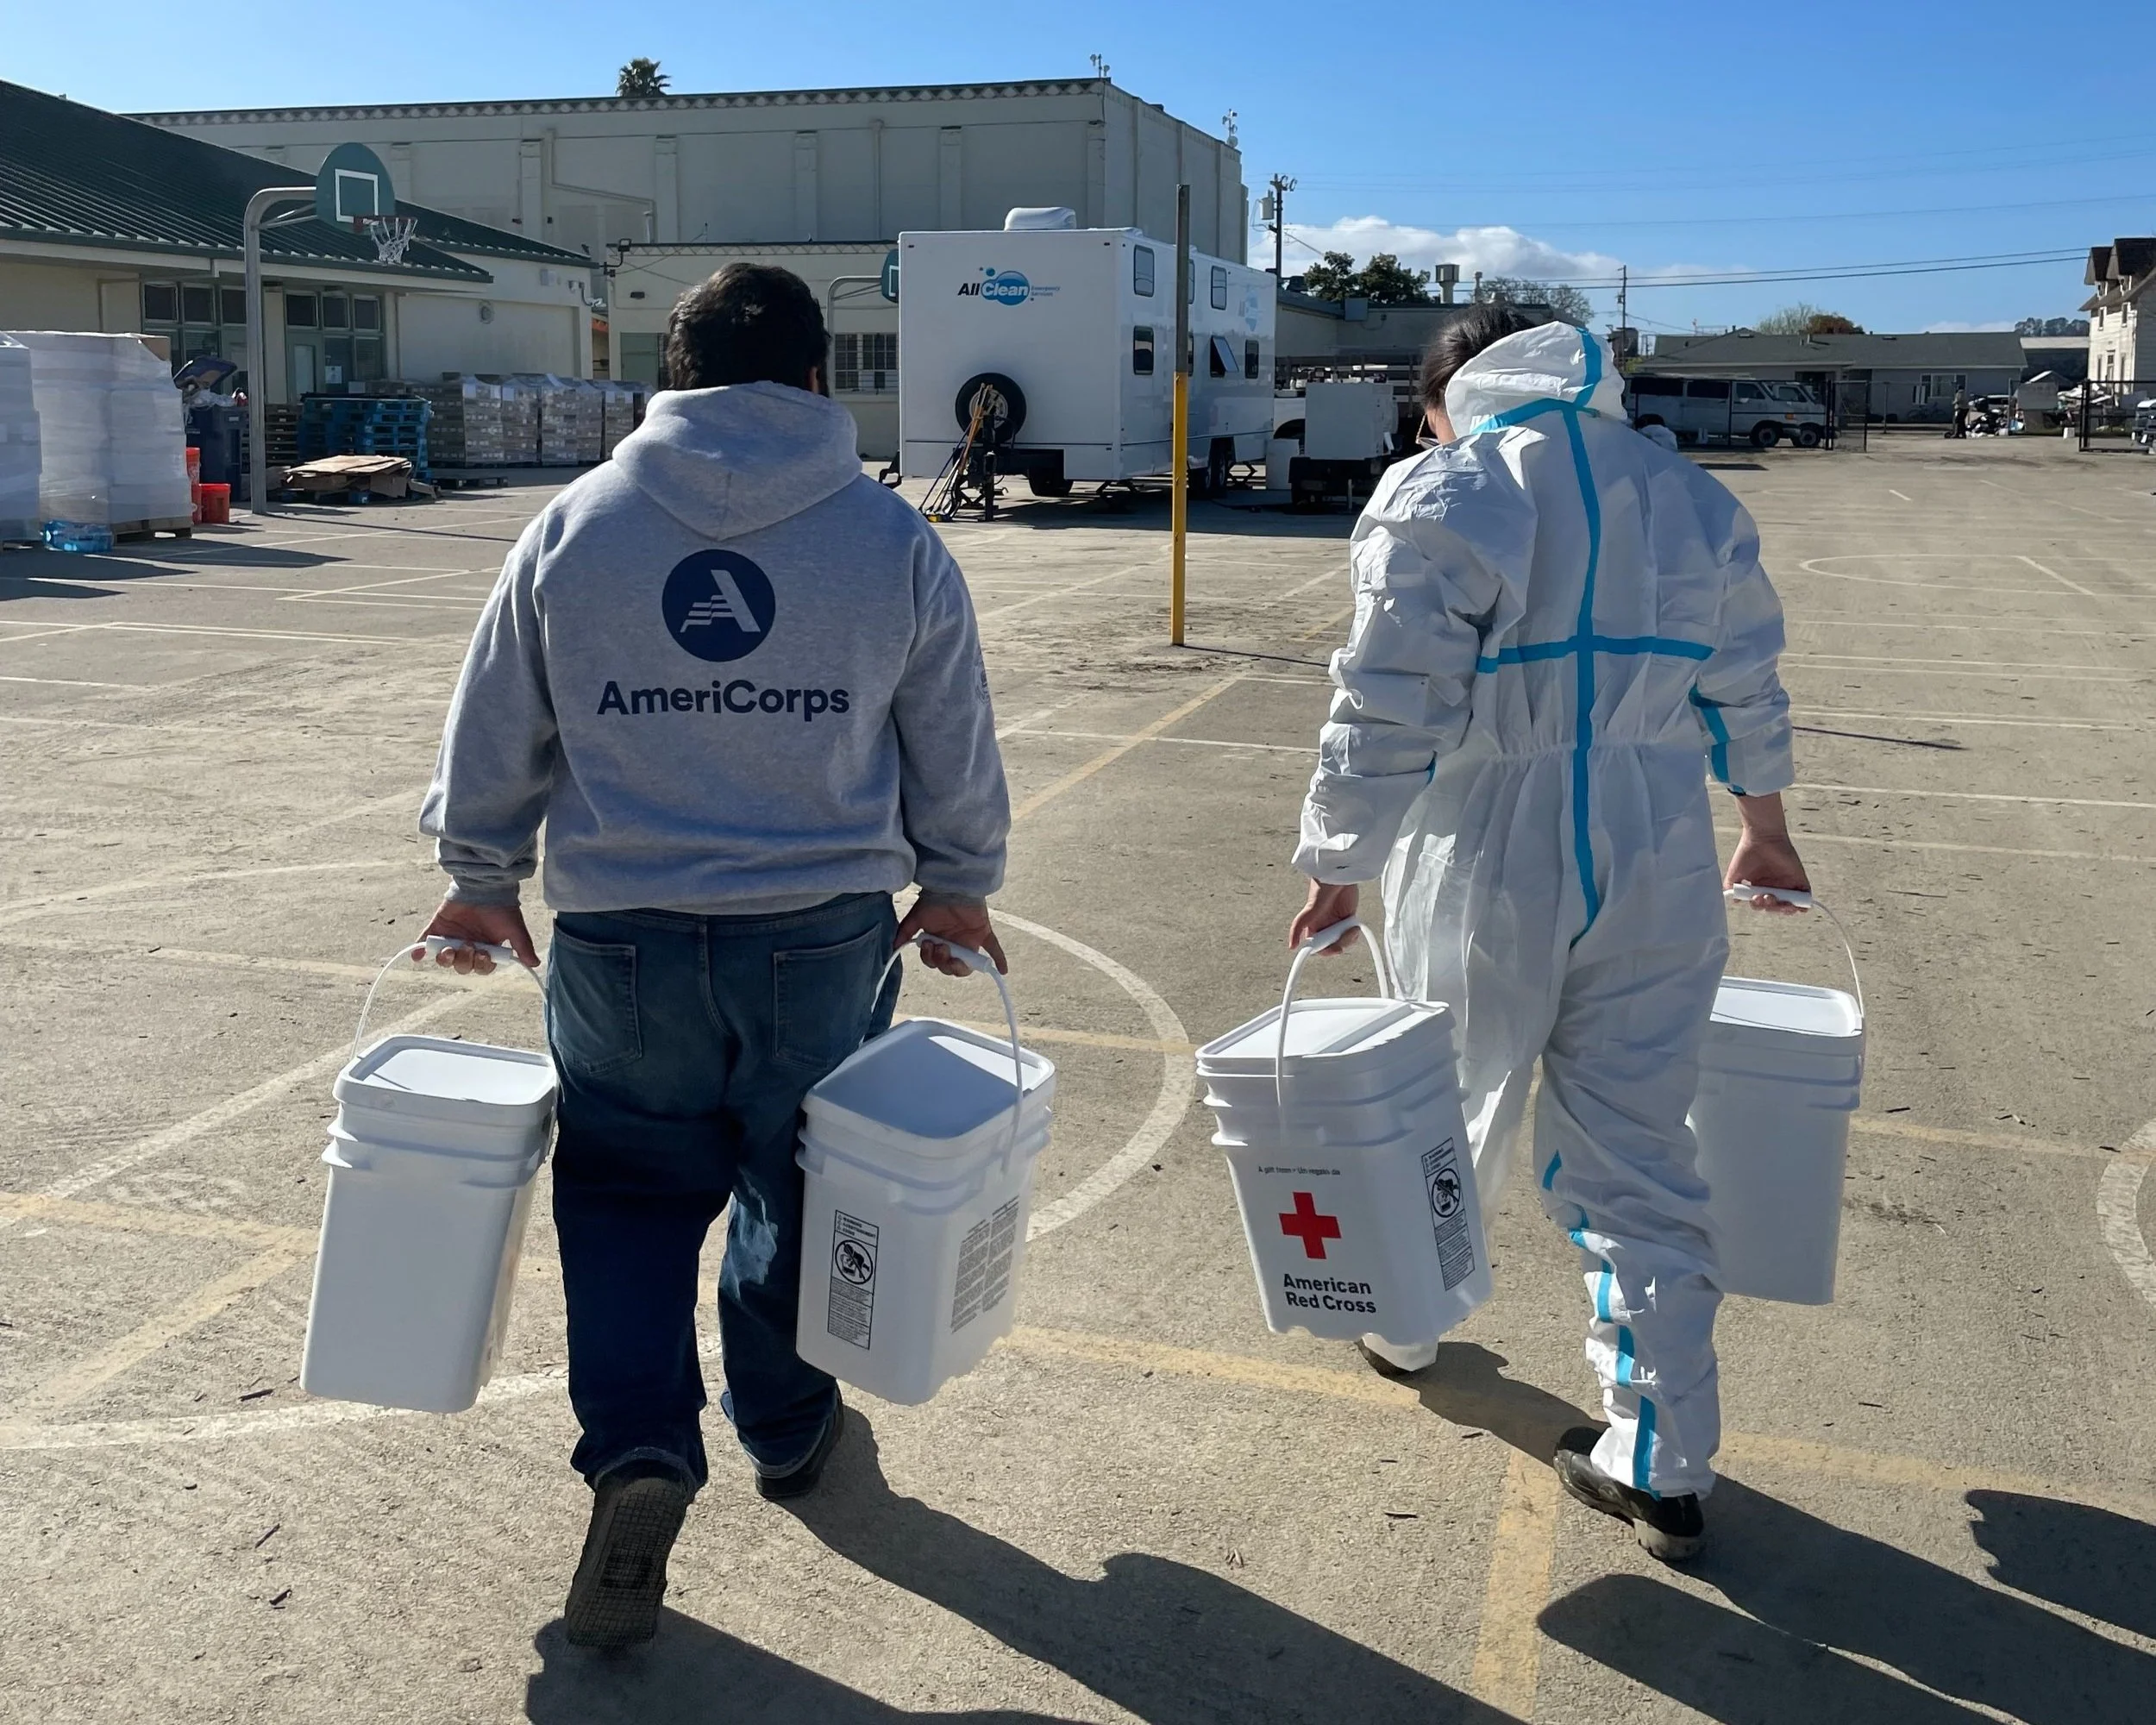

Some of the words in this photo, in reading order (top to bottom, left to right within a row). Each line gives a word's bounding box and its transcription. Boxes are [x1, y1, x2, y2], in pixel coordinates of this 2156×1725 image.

[597, 680, 849, 722] AmeriCorps
[1283, 1274, 1372, 1294] American
[1286, 1292, 1319, 1308] Red
[1323, 1295, 1376, 1314] Cross
